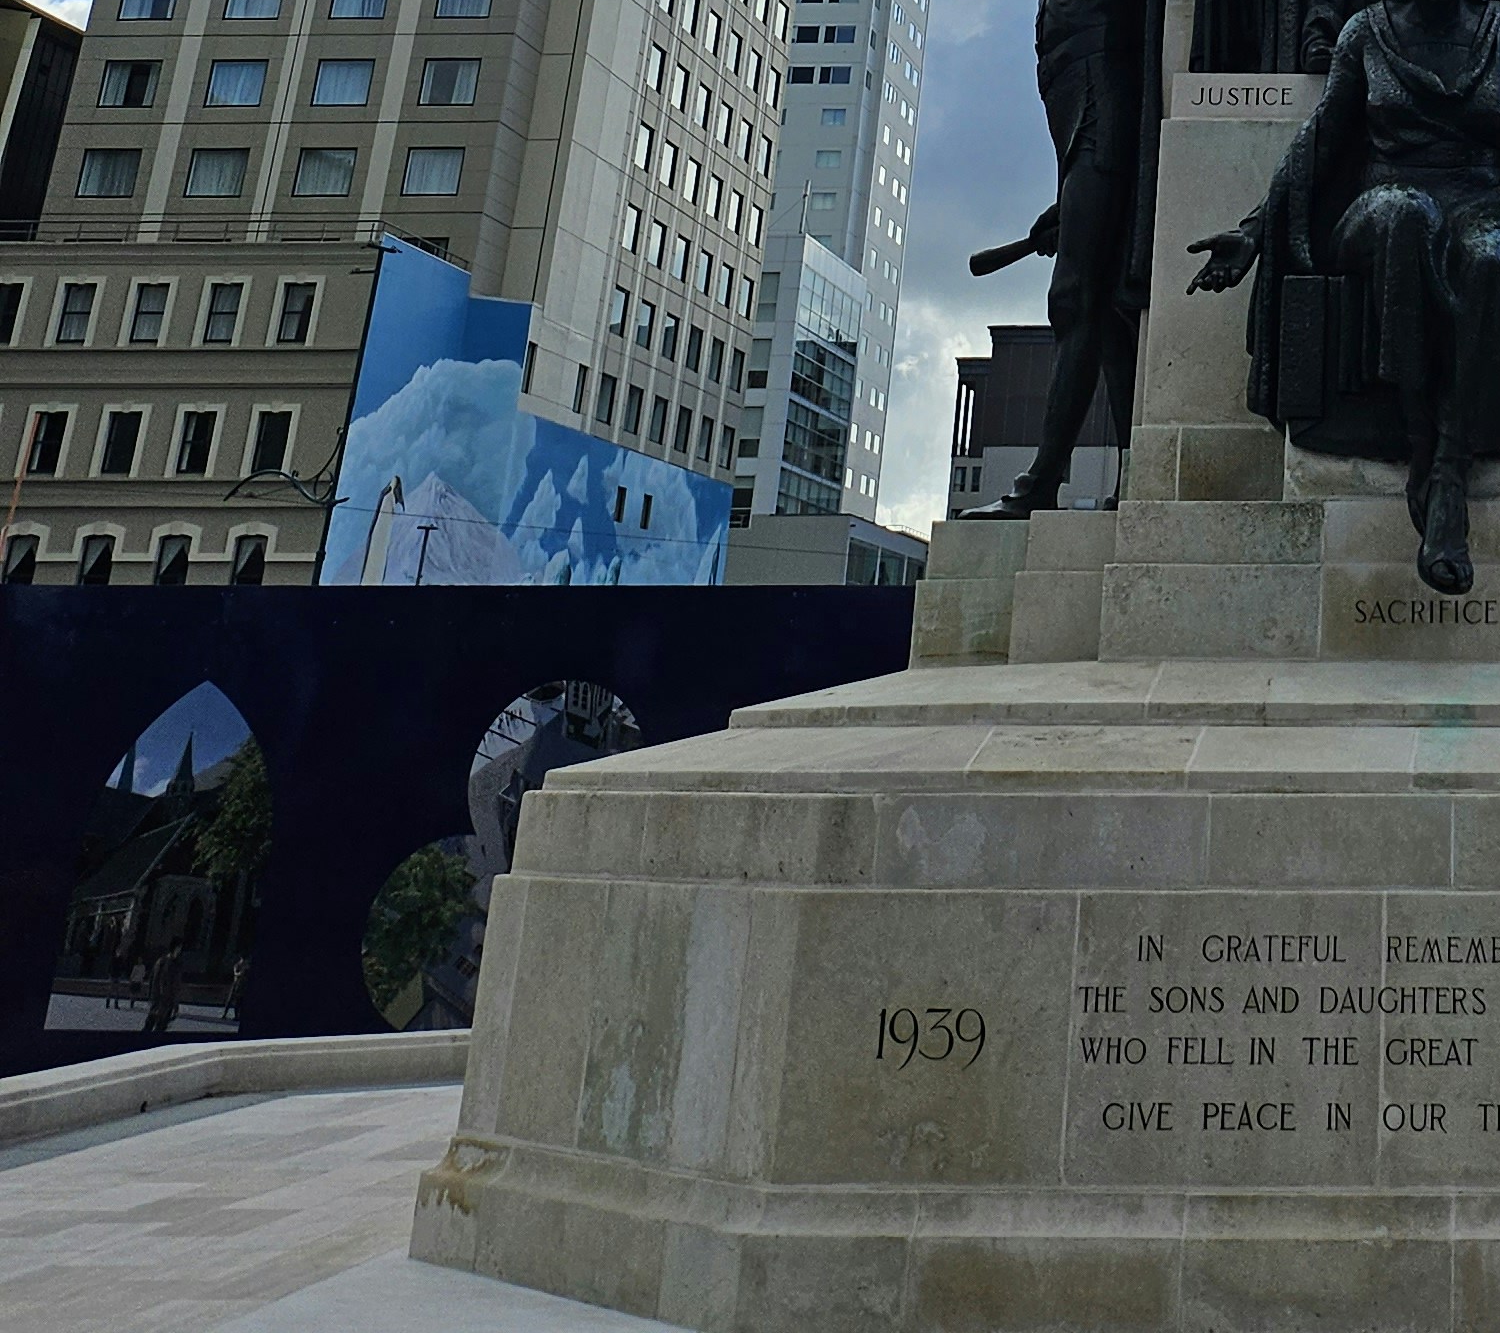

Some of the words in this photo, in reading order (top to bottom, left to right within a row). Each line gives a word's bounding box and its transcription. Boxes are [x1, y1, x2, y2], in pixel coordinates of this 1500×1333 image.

[1190, 86, 1294, 106] JUSTICE
[1354, 599, 1499, 625] SACRIFICE
[1137, 934, 1165, 963] IN
[1201, 934, 1347, 964] GRATEFUL
[1078, 985, 1127, 1014] THE
[1148, 985, 1226, 1014] SONS
[1241, 985, 1300, 1014] AND
[1319, 986, 1487, 1015] DAUGHTERS
[875, 1007, 986, 1072] 1939
[1079, 1036, 1147, 1065] WHO
[1167, 1036, 1235, 1066] FELL
[1249, 1036, 1276, 1066] IN
[1301, 1036, 1360, 1066] THE
[1385, 1038, 1479, 1067] GREAT
[1102, 1102, 1174, 1131] GIVE
[1202, 1101, 1297, 1132] PEACE
[1326, 1102, 1353, 1131] IN
[1382, 1103, 1447, 1133] OUR
